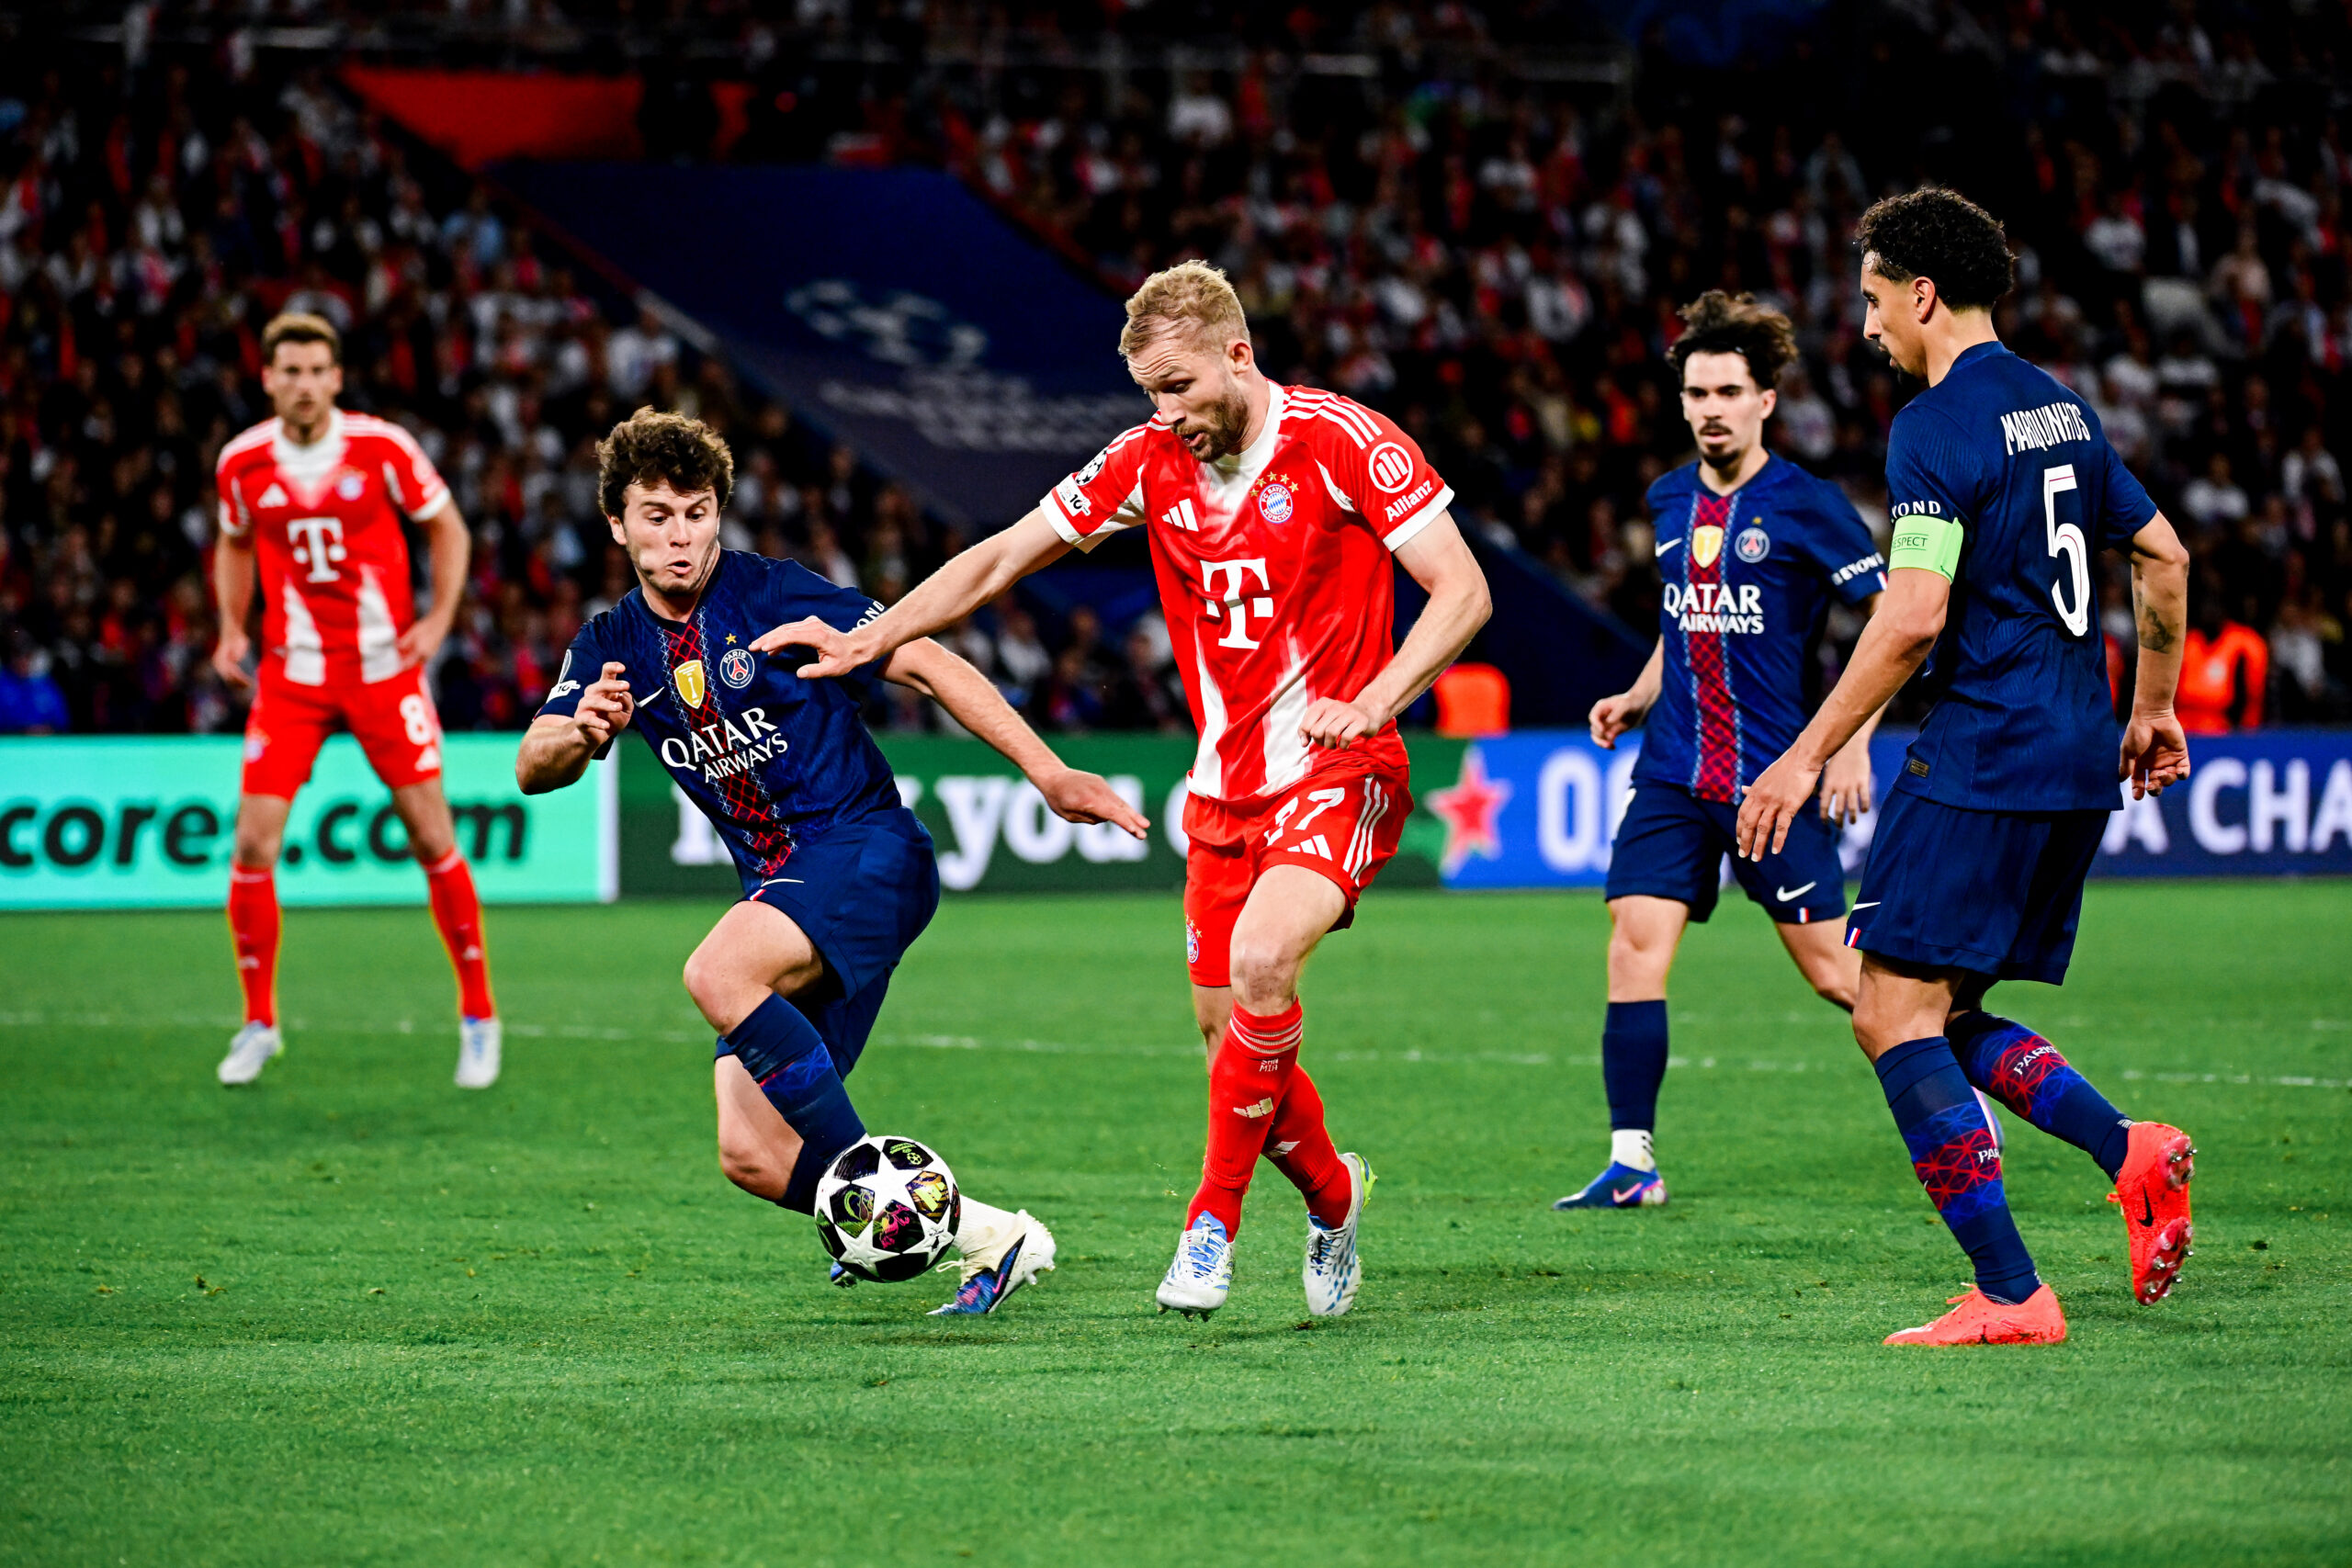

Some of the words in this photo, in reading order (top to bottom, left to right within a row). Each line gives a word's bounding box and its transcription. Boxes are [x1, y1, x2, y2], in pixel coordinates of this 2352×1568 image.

[2000, 401, 2091, 456] MARQUINHOS
[1268, 487, 1291, 500] BAYERN
[1385, 469, 1433, 522] Allianz
[287, 516, 347, 583] T
[1893, 536, 1928, 548] ESPECT
[2043, 463, 2090, 637] 5
[1199, 558, 1273, 649] T
[1664, 582, 1763, 618] QATAR
[1679, 613, 1765, 634] AIRWAYS
[723, 651, 747, 663] PARIS
[399, 693, 433, 745] 8
[662, 707, 778, 772] QATAR
[704, 732, 788, 783] AIRWAYS
[2013, 1046, 2058, 1075] PARIS
